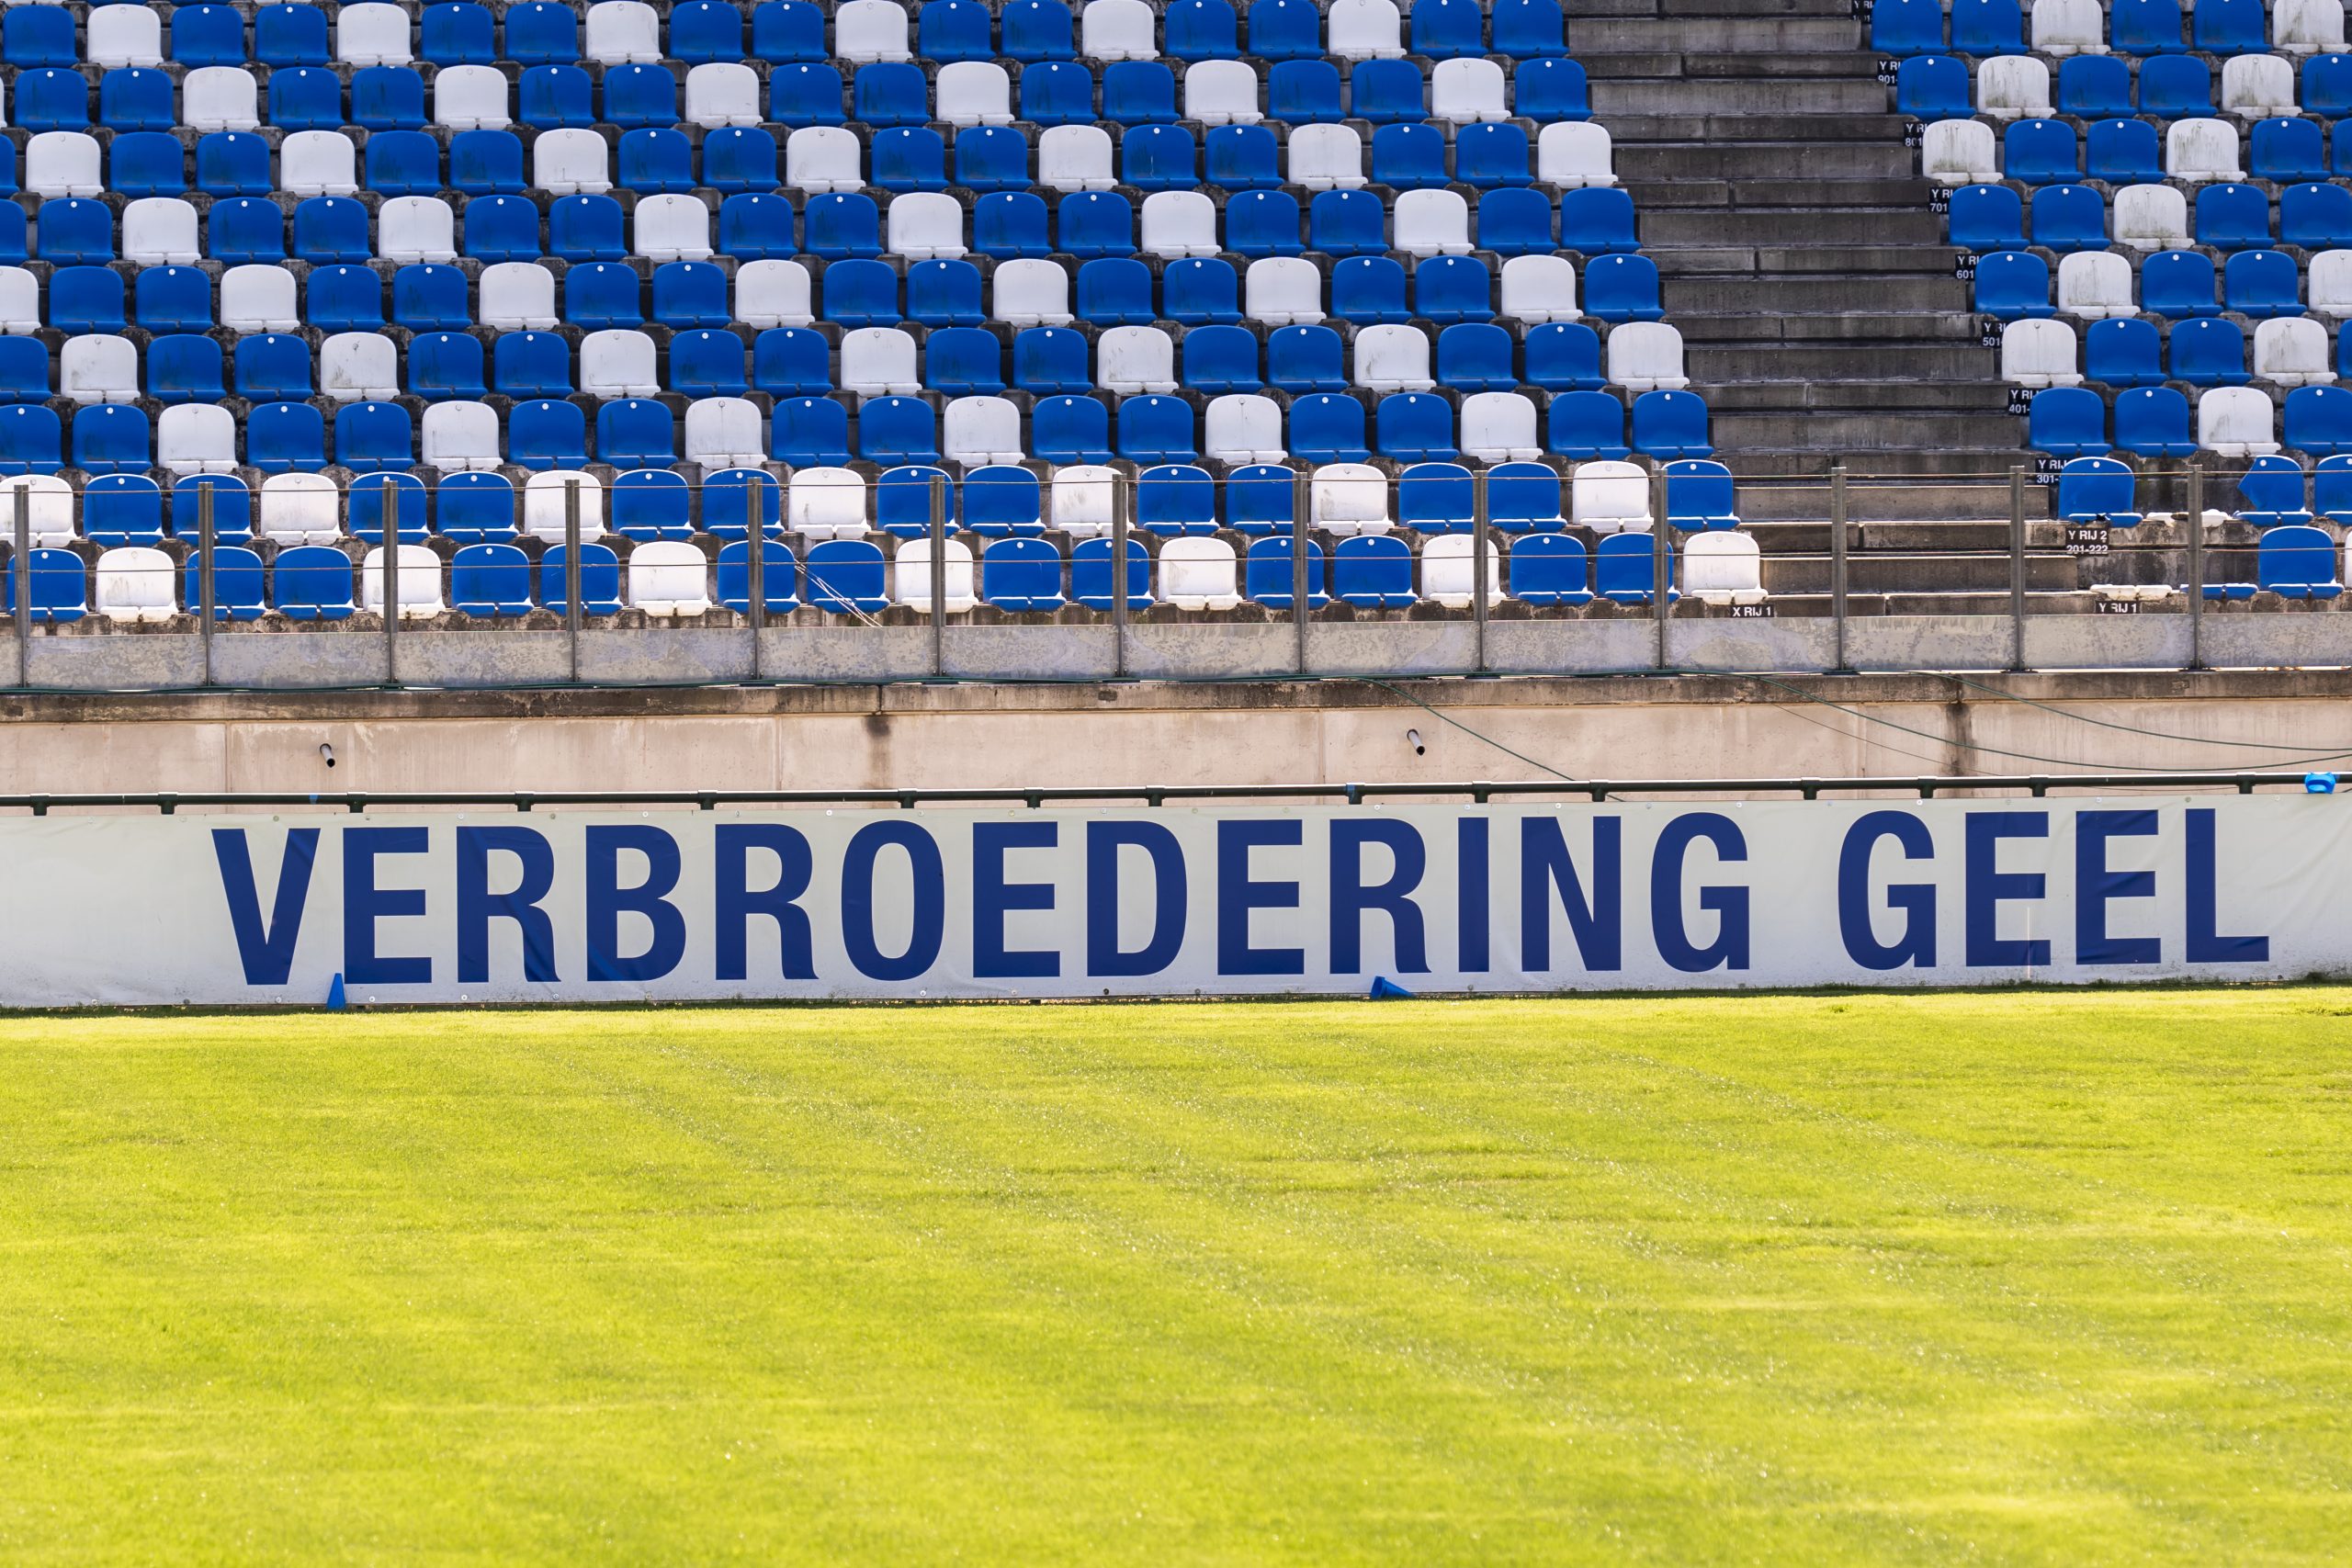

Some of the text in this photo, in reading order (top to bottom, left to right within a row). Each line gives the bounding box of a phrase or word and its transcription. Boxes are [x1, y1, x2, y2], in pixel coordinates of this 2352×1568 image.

[1879, 61, 1887, 71] Y
[1905, 123, 1914, 132] Y
[1931, 189, 1939, 198] Y
[1957, 255, 1965, 265] Y
[1984, 322, 1991, 332] Y
[2010, 389, 2039, 400] Y RI
[2038, 459, 2046, 469] Y
[2068, 530, 2107, 540] Y RIJ 2
[2066, 545, 2108, 555] 201-222
[1732, 606, 1771, 617] X RIJ 1
[2098, 603, 2137, 613] Y RIJ 1
[211, 807, 2269, 986] VERBROEDERING GEEL
